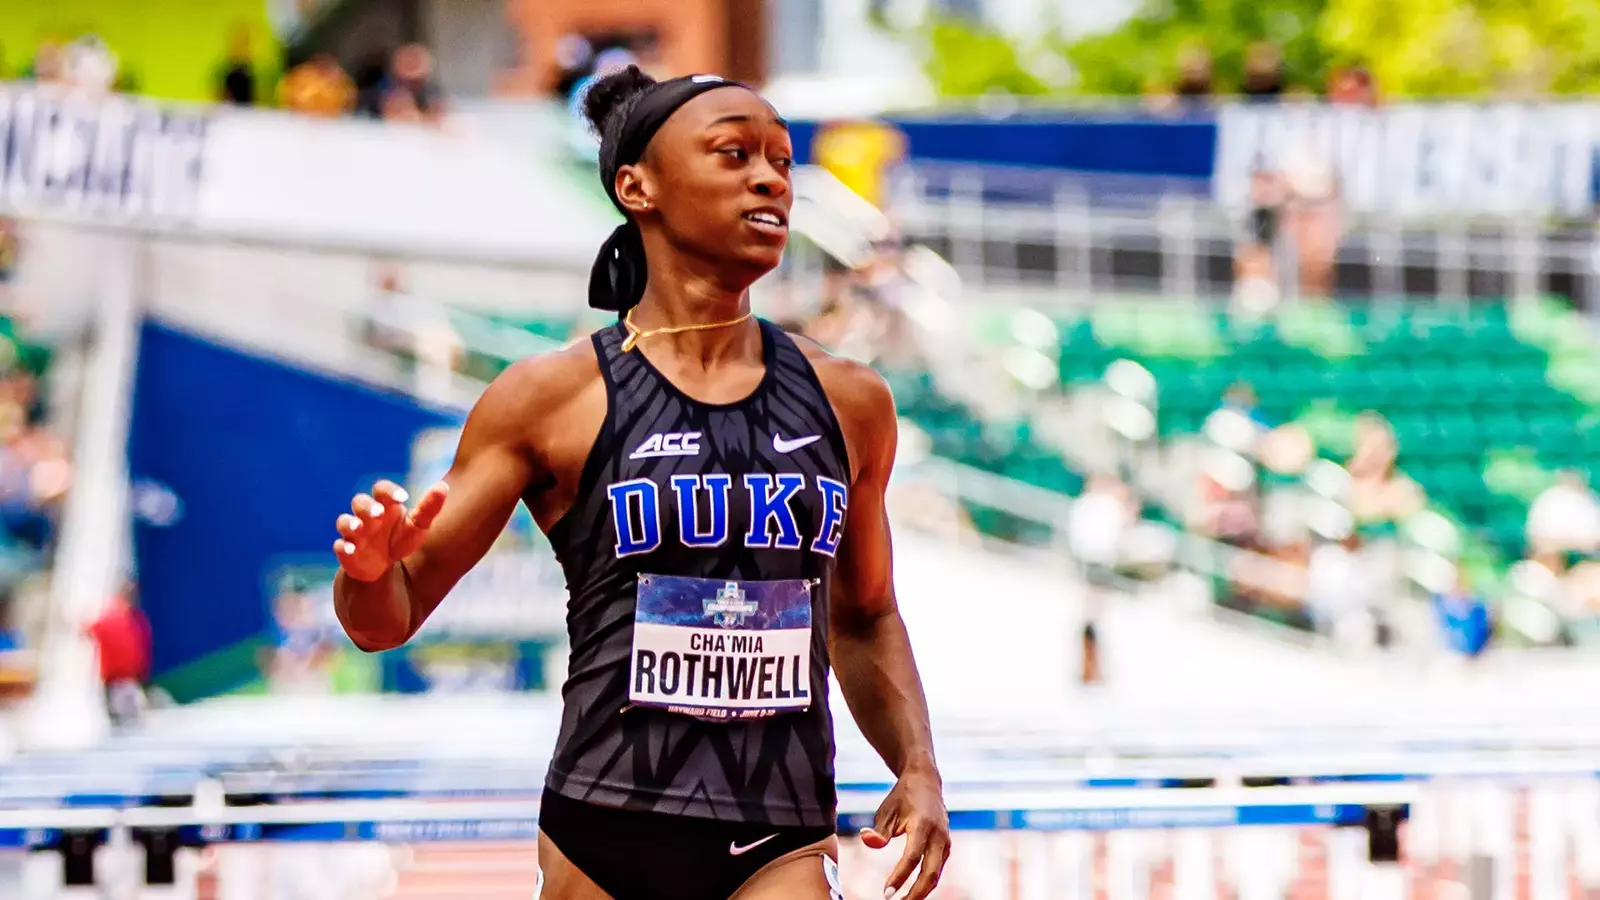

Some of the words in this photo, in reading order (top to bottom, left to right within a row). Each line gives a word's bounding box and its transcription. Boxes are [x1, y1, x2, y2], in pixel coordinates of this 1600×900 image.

[634, 432, 702, 454] ACC
[607, 474, 848, 558] DUKE
[690, 633, 764, 653] CHA'MIA
[634, 649, 809, 700] ROTHWELL
[668, 705, 705, 716] HAYWARD
[705, 708, 728, 718] FIELD
[740, 709, 760, 718] JUNE
